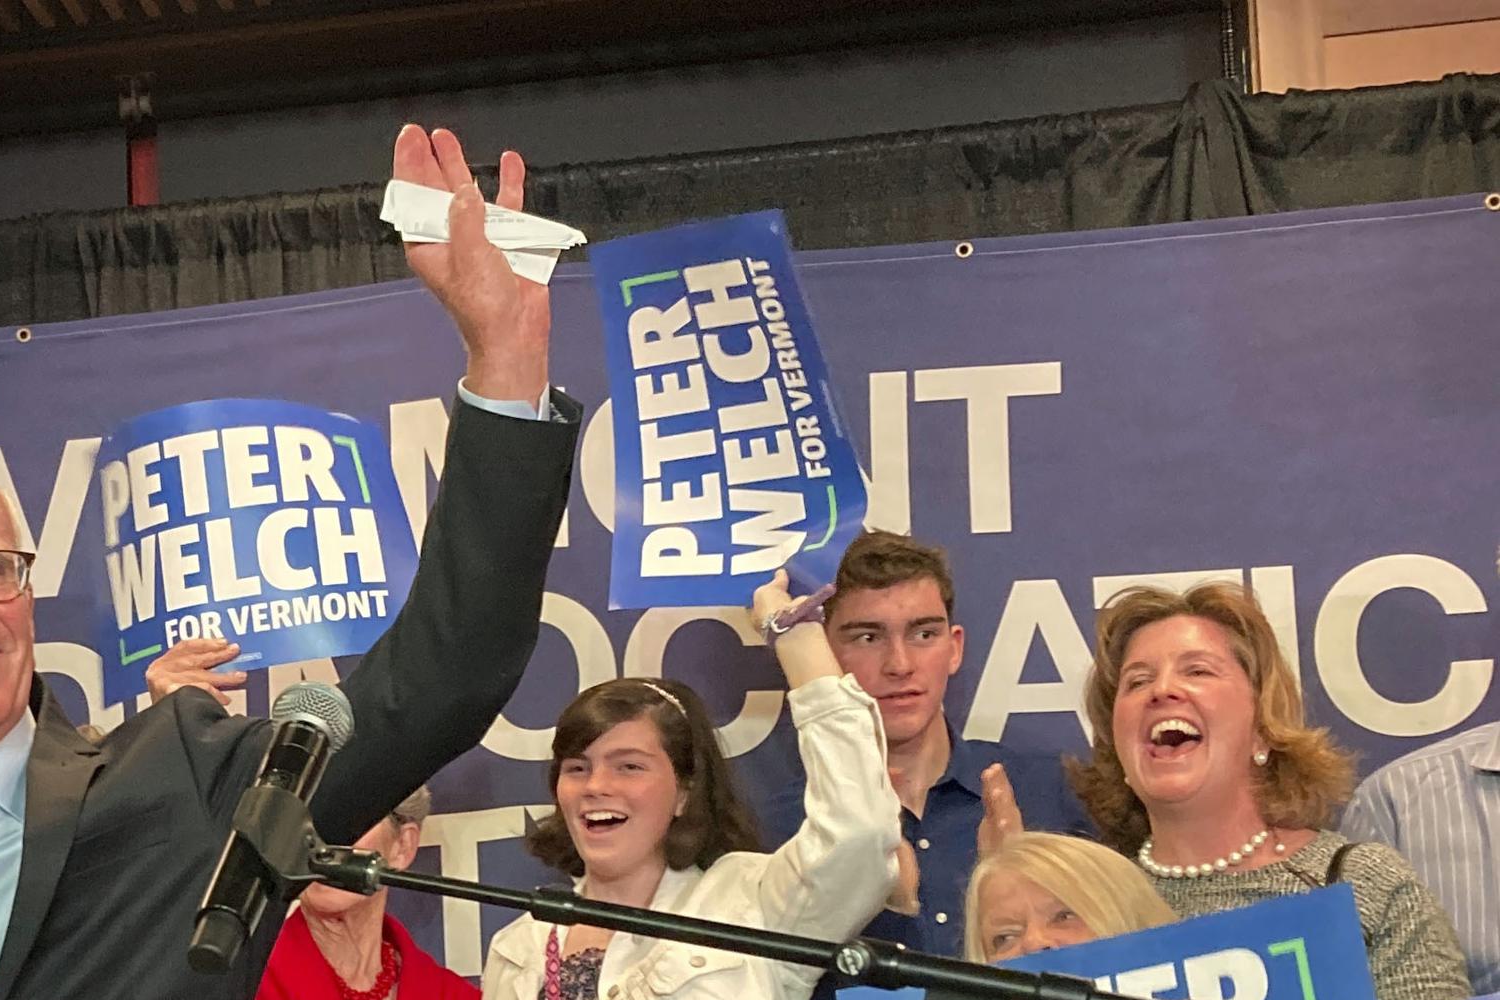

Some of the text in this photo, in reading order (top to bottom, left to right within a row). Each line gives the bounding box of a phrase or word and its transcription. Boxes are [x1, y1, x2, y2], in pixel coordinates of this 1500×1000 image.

[628, 296, 723, 577] PETER
[683, 259, 807, 576] WELCH
[746, 257, 831, 479] FOR VERMONT
[101, 425, 346, 546] PETER
[105, 507, 387, 631] WELCH
[165, 590, 389, 648] FOR VERMONT
